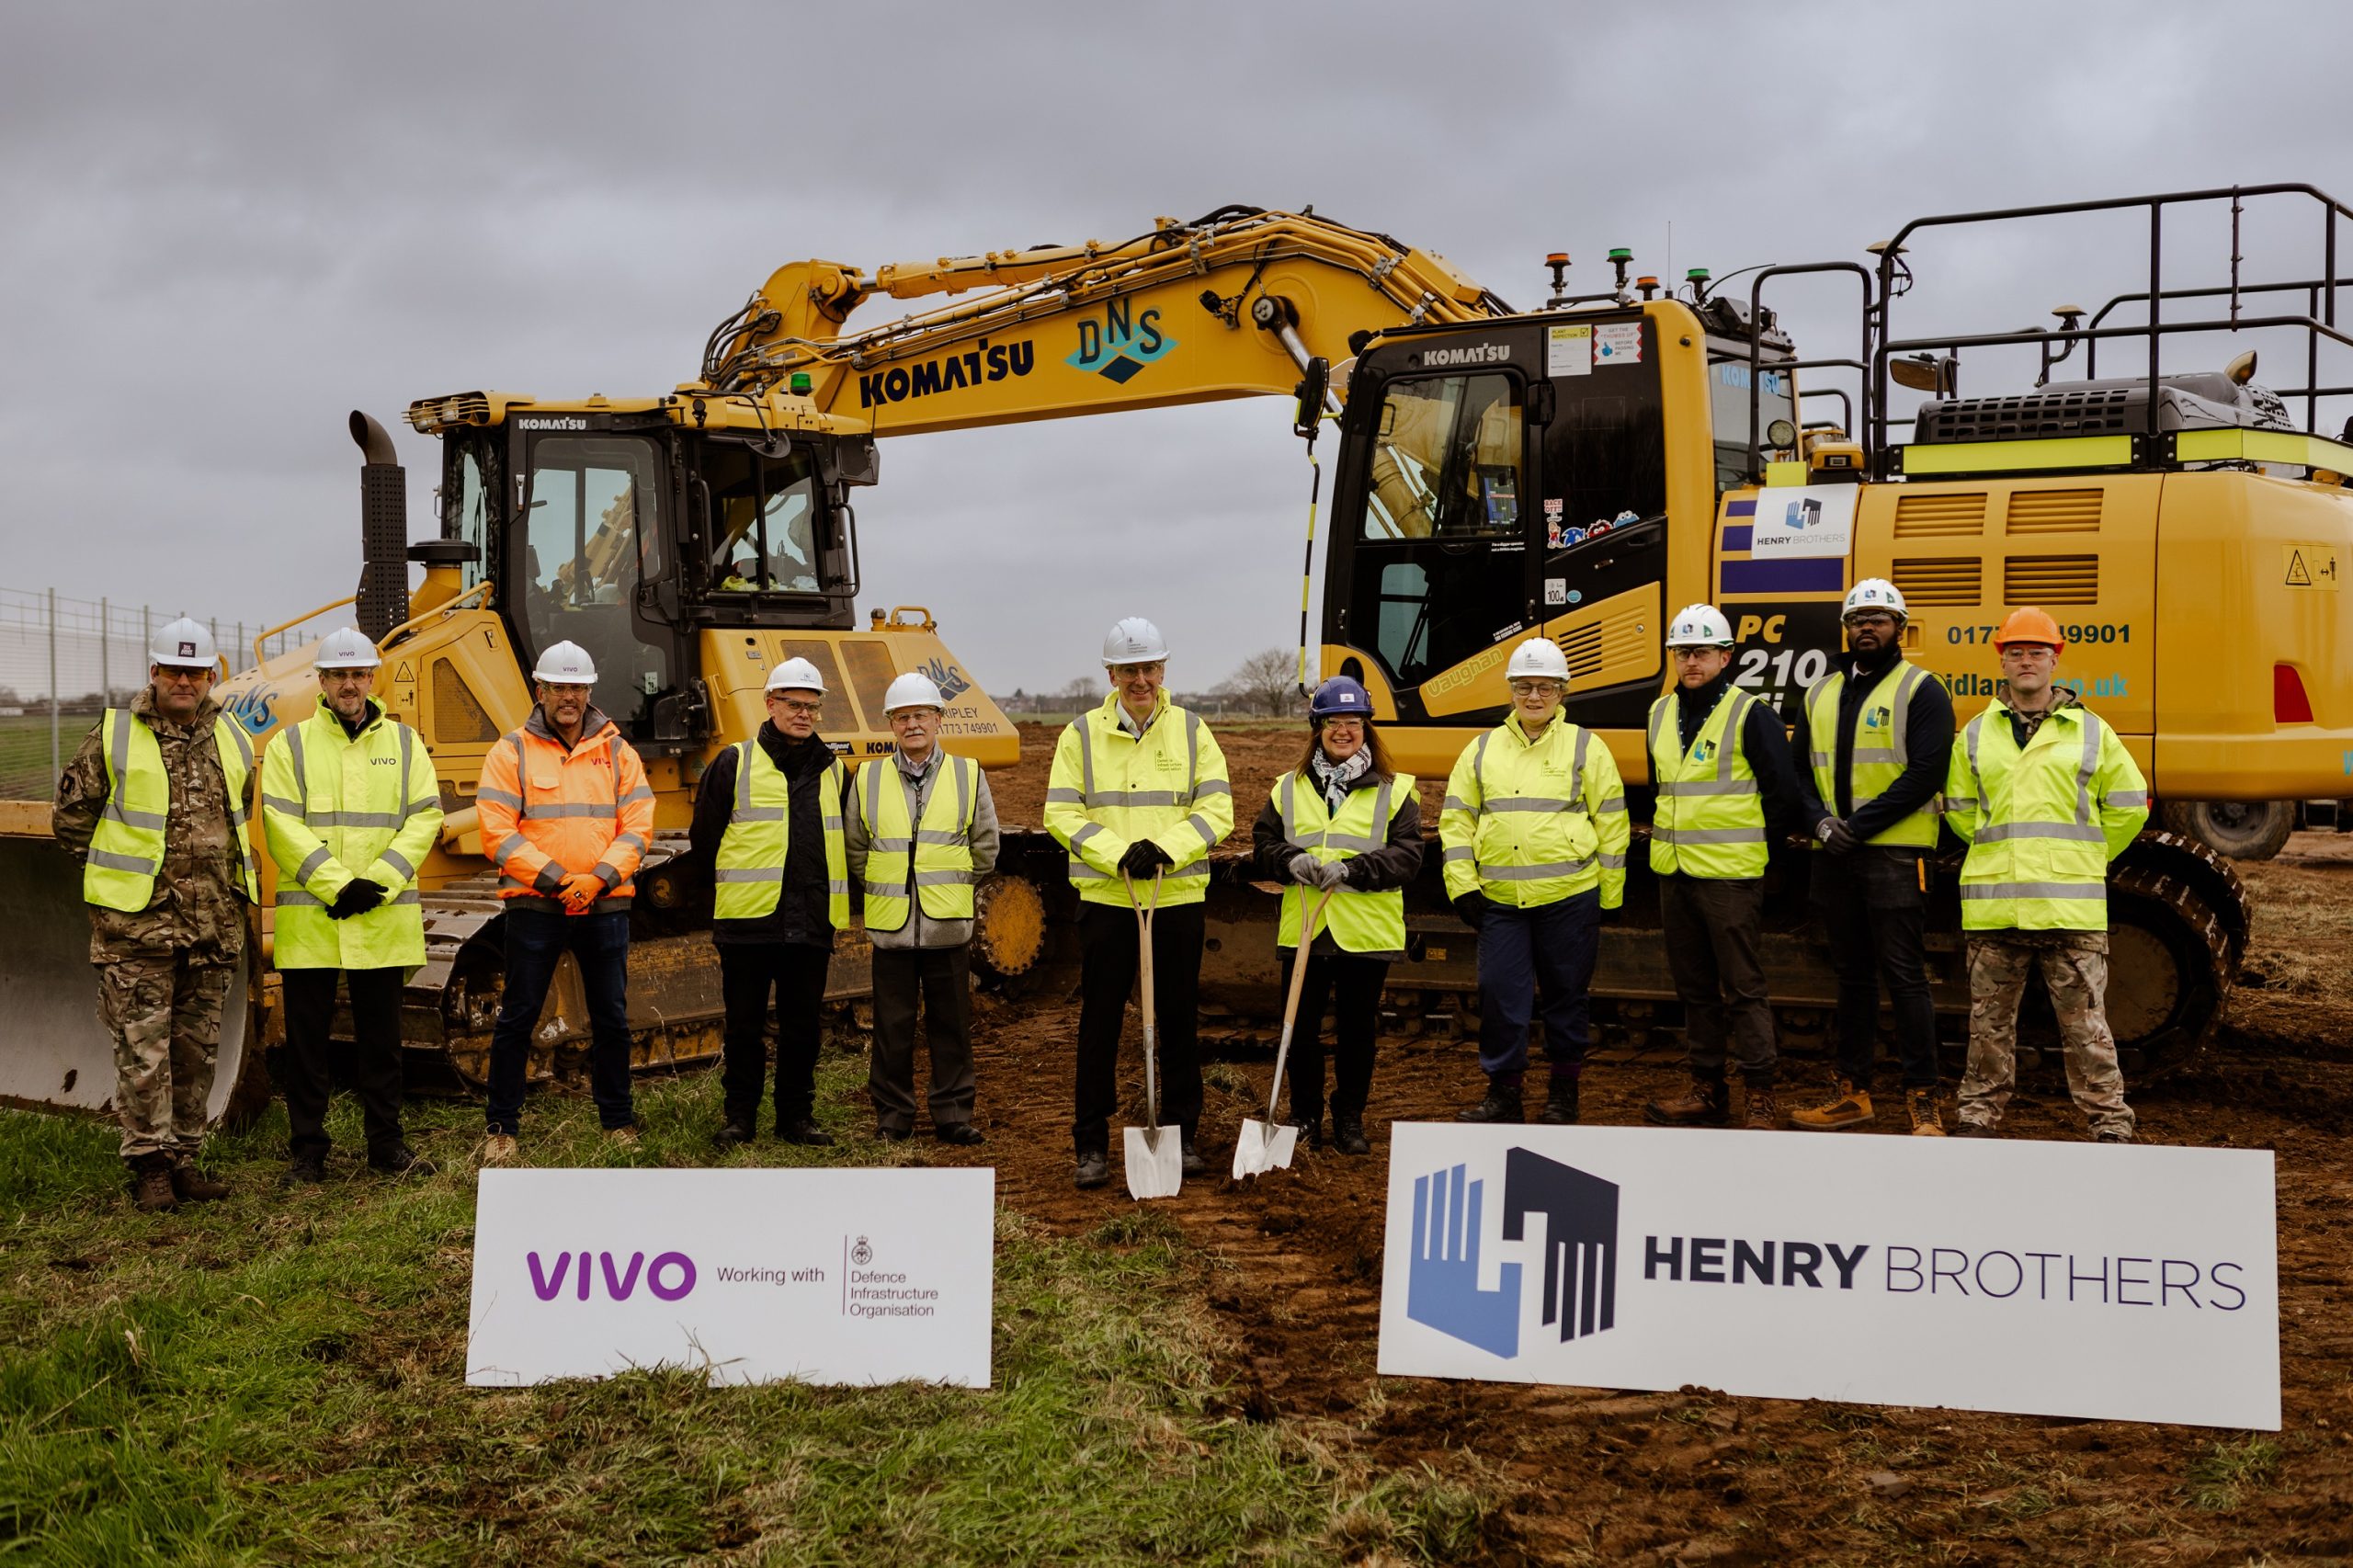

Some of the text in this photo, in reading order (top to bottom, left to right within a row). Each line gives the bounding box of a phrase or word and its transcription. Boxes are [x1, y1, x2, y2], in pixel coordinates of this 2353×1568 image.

[1077, 296, 1163, 365] DNS
[1424, 343, 1510, 366] KOMATSU
[859, 338, 1034, 408] KOMATSU
[1721, 364, 1780, 395] KOMSU
[518, 416, 586, 430] KOMATSU
[1756, 534, 1846, 545] HENRY BROTHERS
[1548, 590, 1560, 602] 100
[1734, 614, 1787, 643] PC
[1426, 648, 1505, 698] Vaughan
[1733, 649, 1827, 687] 210
[943, 707, 979, 719] RIPLEY
[964, 722, 999, 734] 749901
[370, 757, 396, 766] VIVO
[526, 1251, 824, 1301] VIVO Working with
[851, 1270, 906, 1283] Defence
[1644, 1235, 2245, 1312] HENRY BROTHERS
[850, 1287, 938, 1300] Infrastructure
[849, 1302, 934, 1319] Organisation
